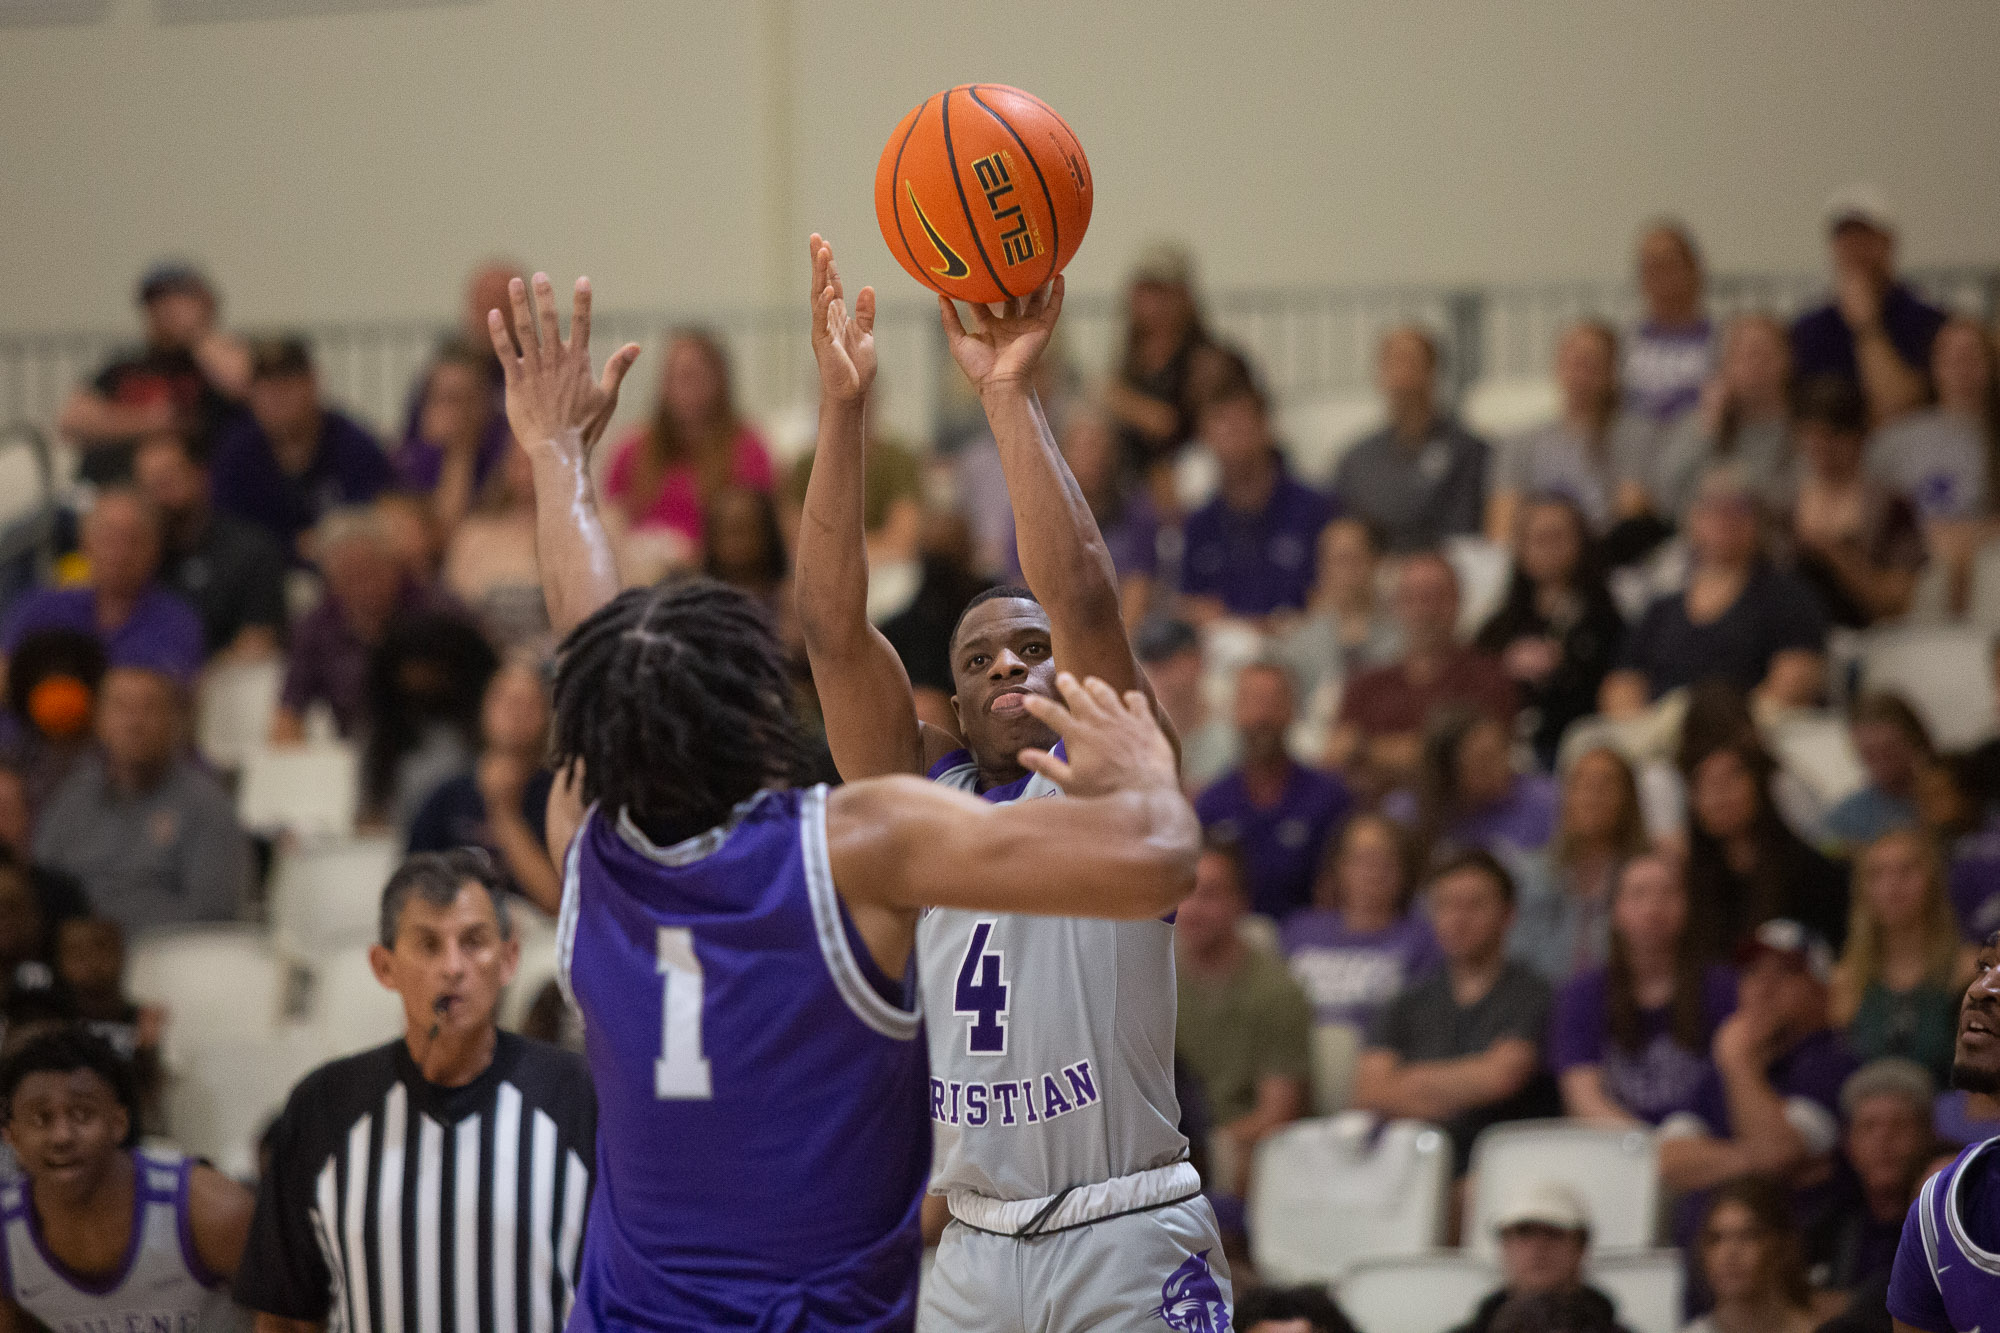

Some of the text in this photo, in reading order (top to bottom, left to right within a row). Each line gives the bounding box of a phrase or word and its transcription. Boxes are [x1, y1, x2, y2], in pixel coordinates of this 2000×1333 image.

[971, 152, 1036, 267] ELITE
[655, 926, 713, 1100] 1
[953, 918, 1011, 1056] 4
[930, 1058, 1101, 1127] RISTIAN
